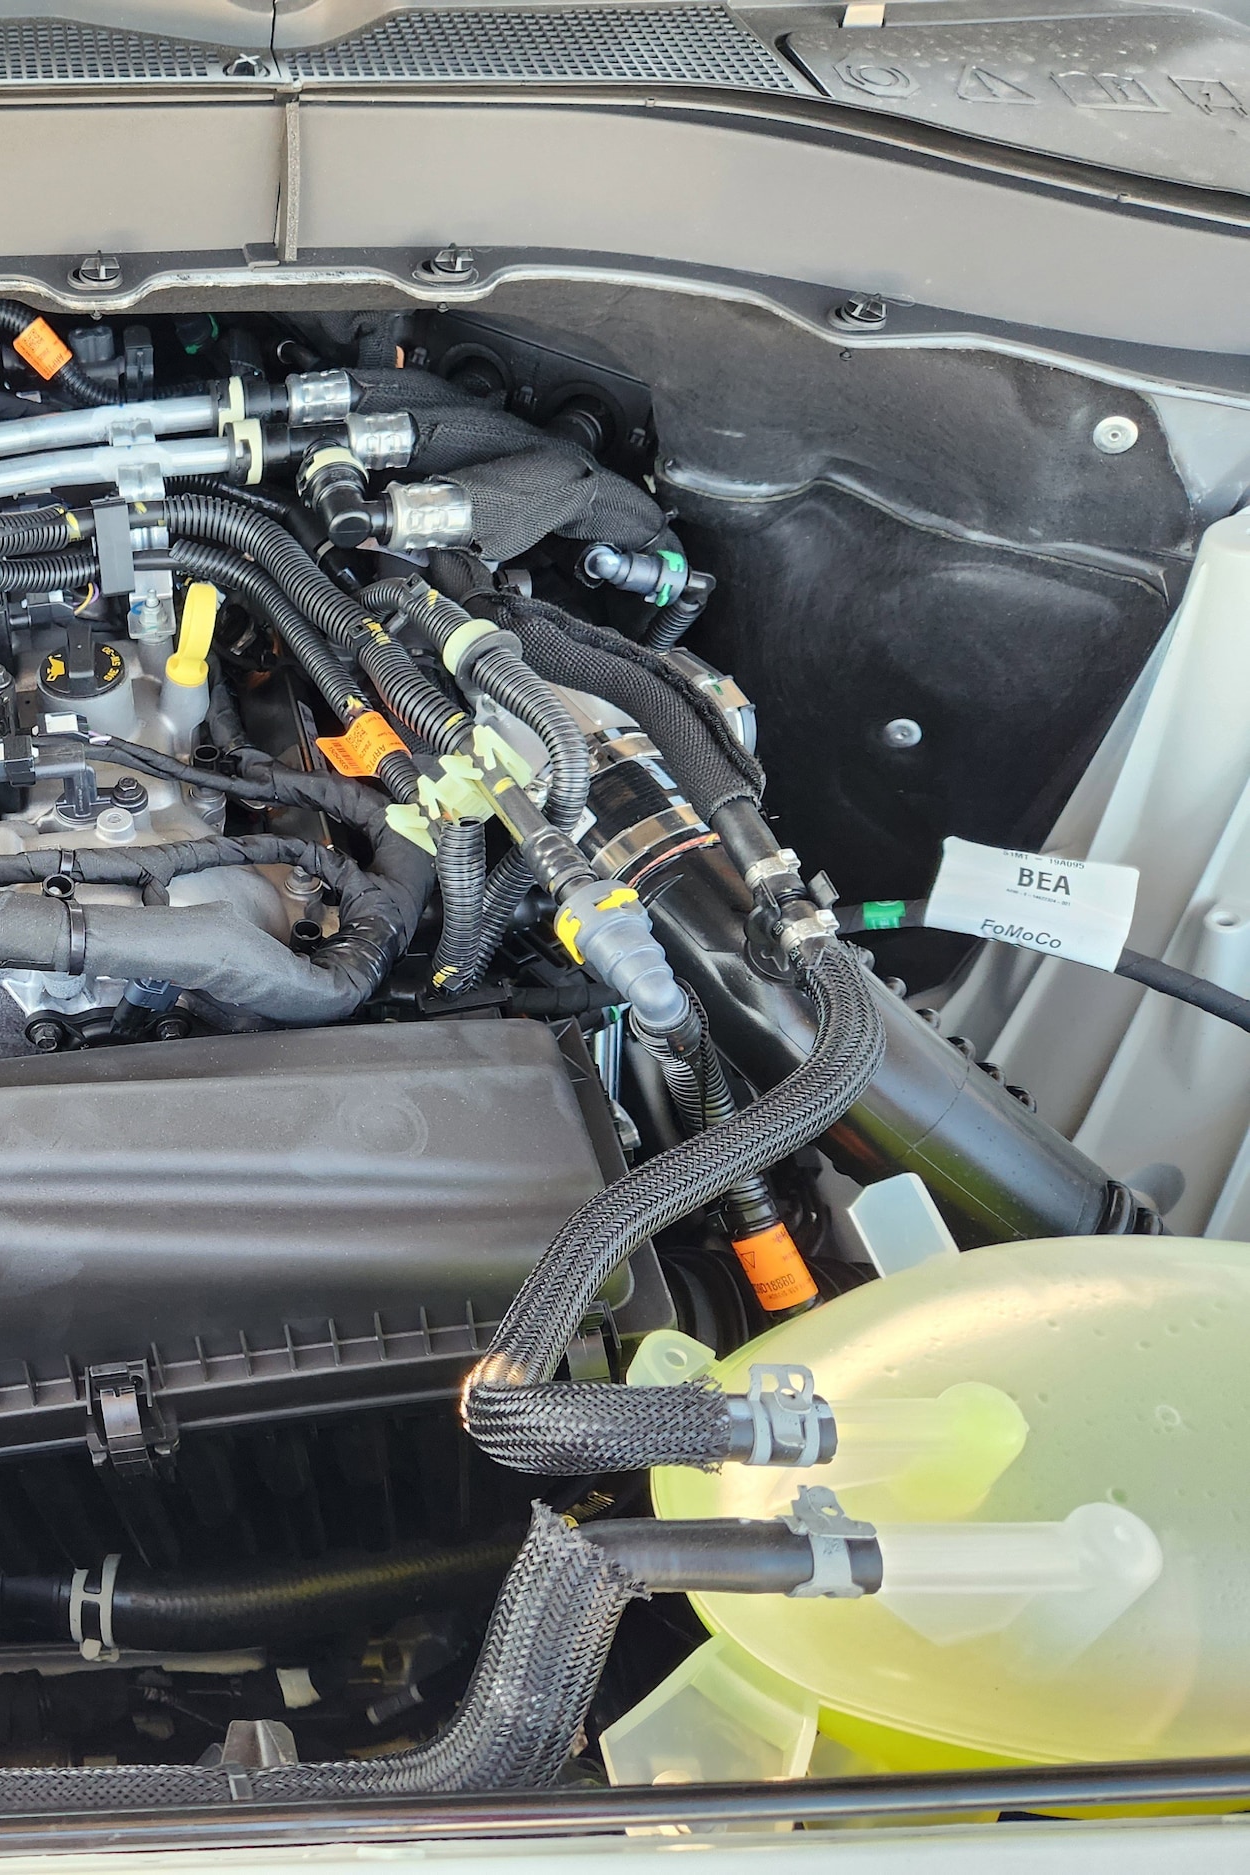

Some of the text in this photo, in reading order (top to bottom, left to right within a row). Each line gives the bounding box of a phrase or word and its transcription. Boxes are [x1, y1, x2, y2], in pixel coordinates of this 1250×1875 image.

[101, 646, 122, 682] SAE 5W-30
[365, 744, 387, 773] ARPTC
[1049, 858, 1085, 870] 19A095
[1017, 867, 1071, 896] BEA
[980, 918, 1062, 950] FoMoCo
